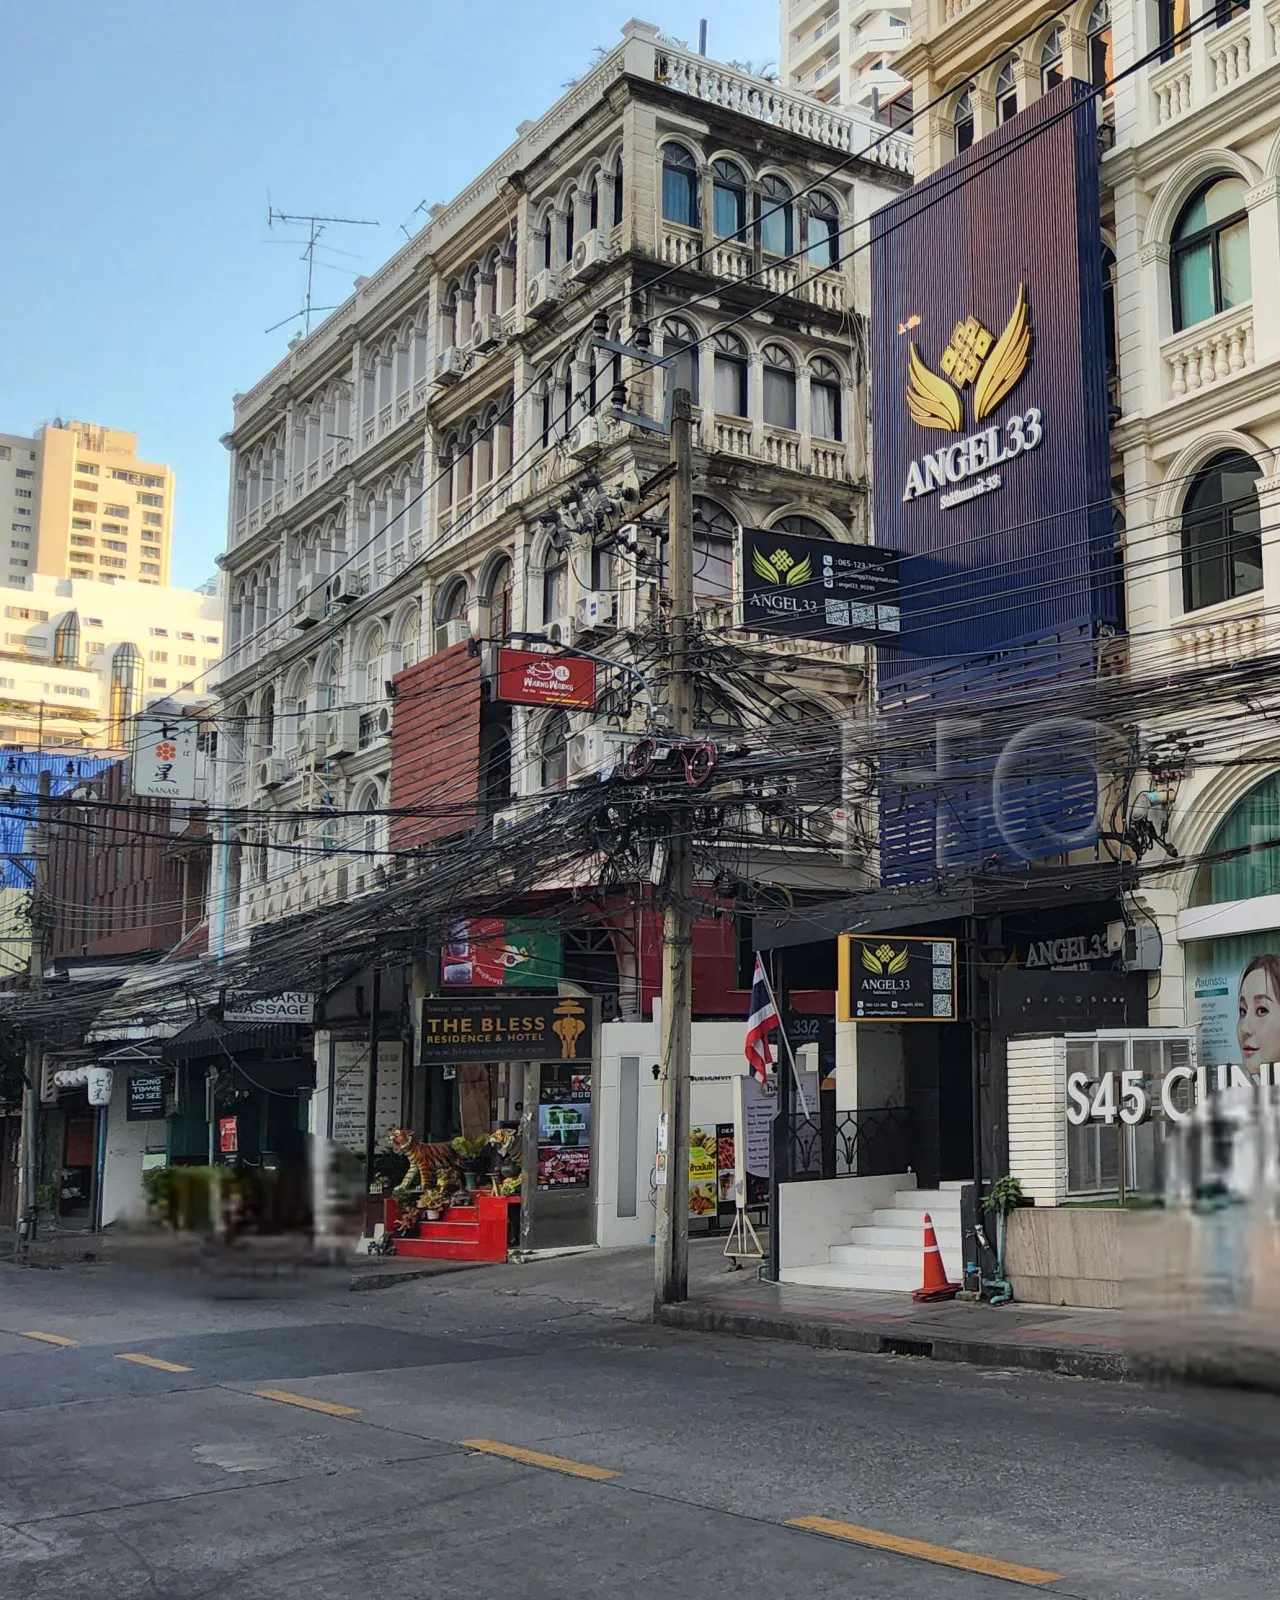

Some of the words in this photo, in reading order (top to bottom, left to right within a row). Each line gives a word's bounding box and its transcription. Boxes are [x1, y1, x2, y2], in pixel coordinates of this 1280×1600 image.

[147, 786, 181, 795] NANASE
[861, 979, 911, 990] ANGEL33
[427, 1018, 473, 1033] THE
[481, 1016, 546, 1033] BLESS
[793, 1020, 820, 1034] 33/2
[426, 1034, 492, 1044] RESIDENCE
[507, 1032, 545, 1042] HOTEL
[146, 1092, 162, 1100] SEE
[1066, 1070, 1147, 1126] S45
